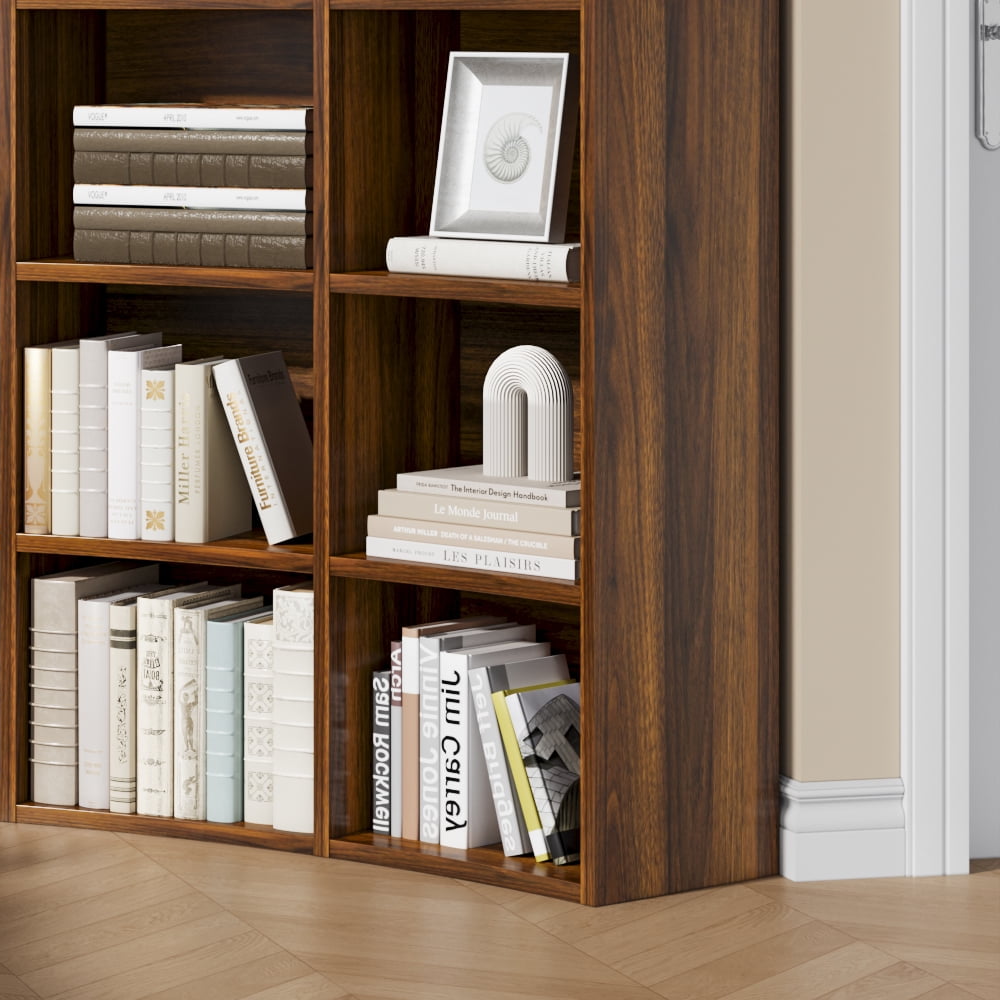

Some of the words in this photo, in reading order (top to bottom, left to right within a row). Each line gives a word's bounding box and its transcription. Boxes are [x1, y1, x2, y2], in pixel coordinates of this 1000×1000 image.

[226, 391, 249, 444] Brands
[178, 453, 190, 504] Miller
[244, 446, 271, 511] Furniture
[451, 484, 462, 493] The
[463, 485, 488, 496] Interior
[488, 488, 511, 499] Design
[513, 490, 548, 501] Handbook
[434, 503, 444, 514] Le
[447, 505, 481, 519] Monde
[482, 509, 519, 523] Journal
[417, 528, 438, 537] MILLER
[443, 549, 468, 563] LES
[475, 553, 542, 572] PLAISIRS
